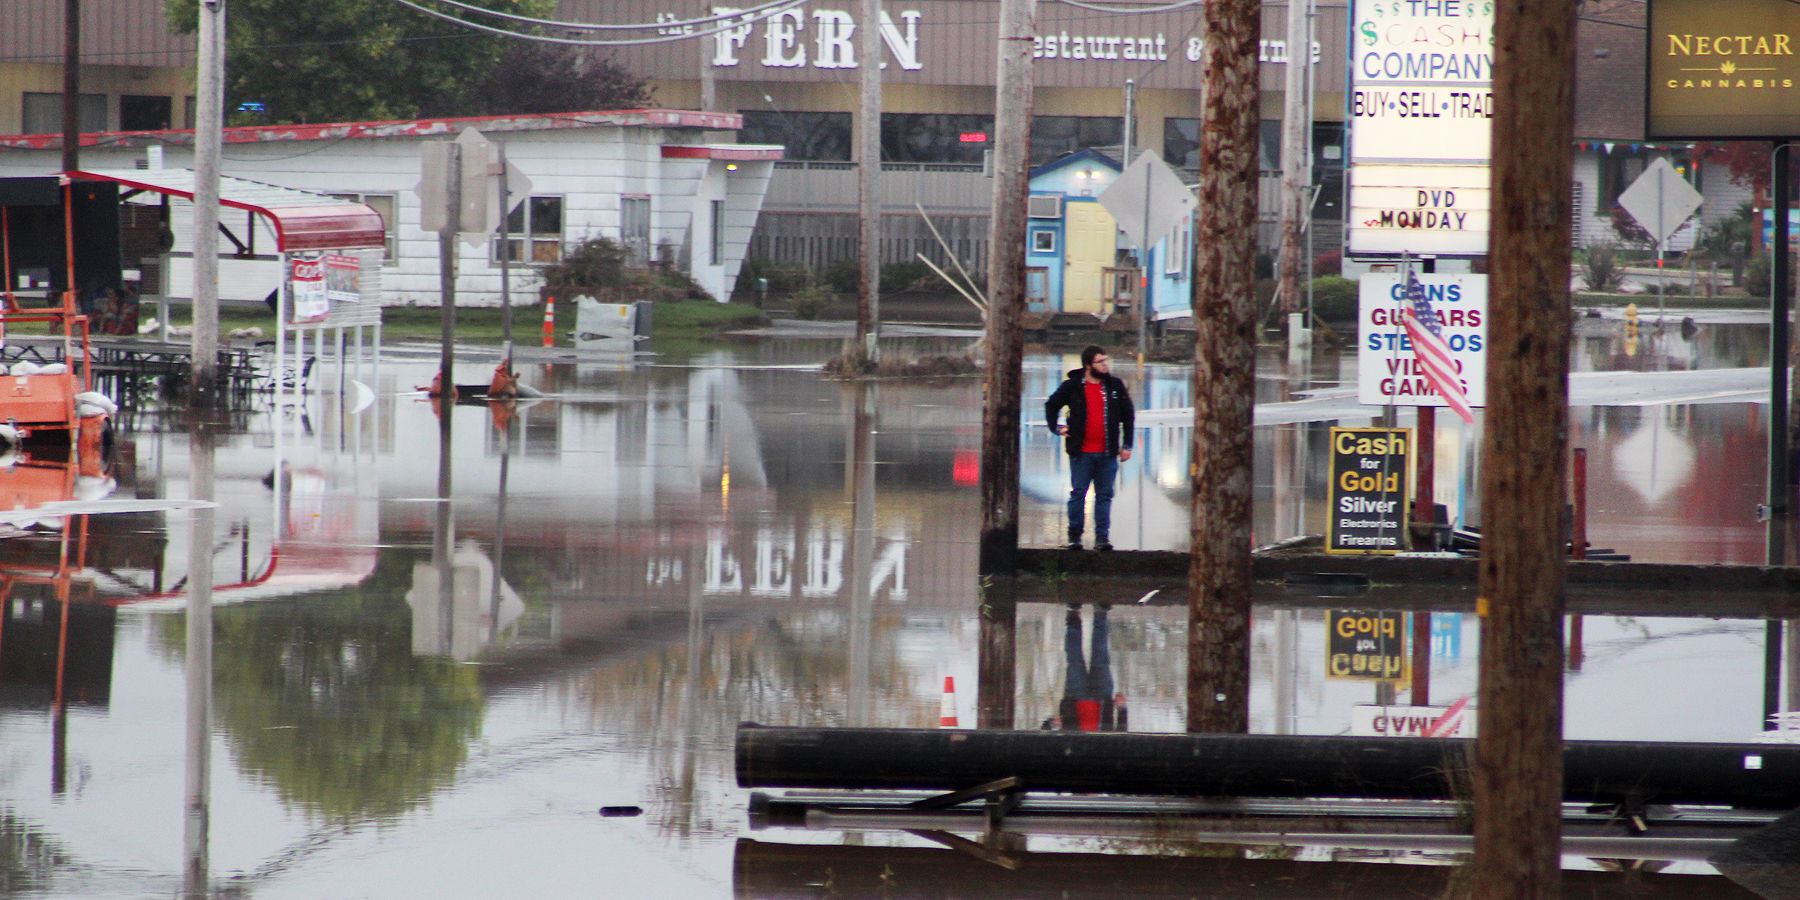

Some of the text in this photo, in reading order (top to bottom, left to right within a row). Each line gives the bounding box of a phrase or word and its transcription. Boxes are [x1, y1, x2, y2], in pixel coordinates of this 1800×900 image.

[1405, 0, 1461, 17] THE
[712, 7, 923, 71] FERN
[1033, 31, 1167, 61] estaurant
[1386, 23, 1481, 47] CASH
[1667, 33, 1794, 56] NECTAR
[1363, 52, 1494, 79] COMPANY
[1667, 79, 1793, 88] CANNABIS
[1354, 91, 1494, 119] BUY SELL TRAD
[1418, 190, 1455, 208] DVD
[1380, 210, 1467, 230] MONDAY
[1391, 283, 1461, 302] GNS
[1371, 308, 1482, 327] GUARS
[1368, 333, 1482, 352] STEOS
[1336, 432, 1405, 455] Cash
[1360, 458, 1381, 469] for
[1340, 470, 1398, 492] Gold
[1340, 497, 1397, 513] Silver
[1340, 518, 1398, 528] Electronics
[1339, 534, 1397, 546] Firearms
